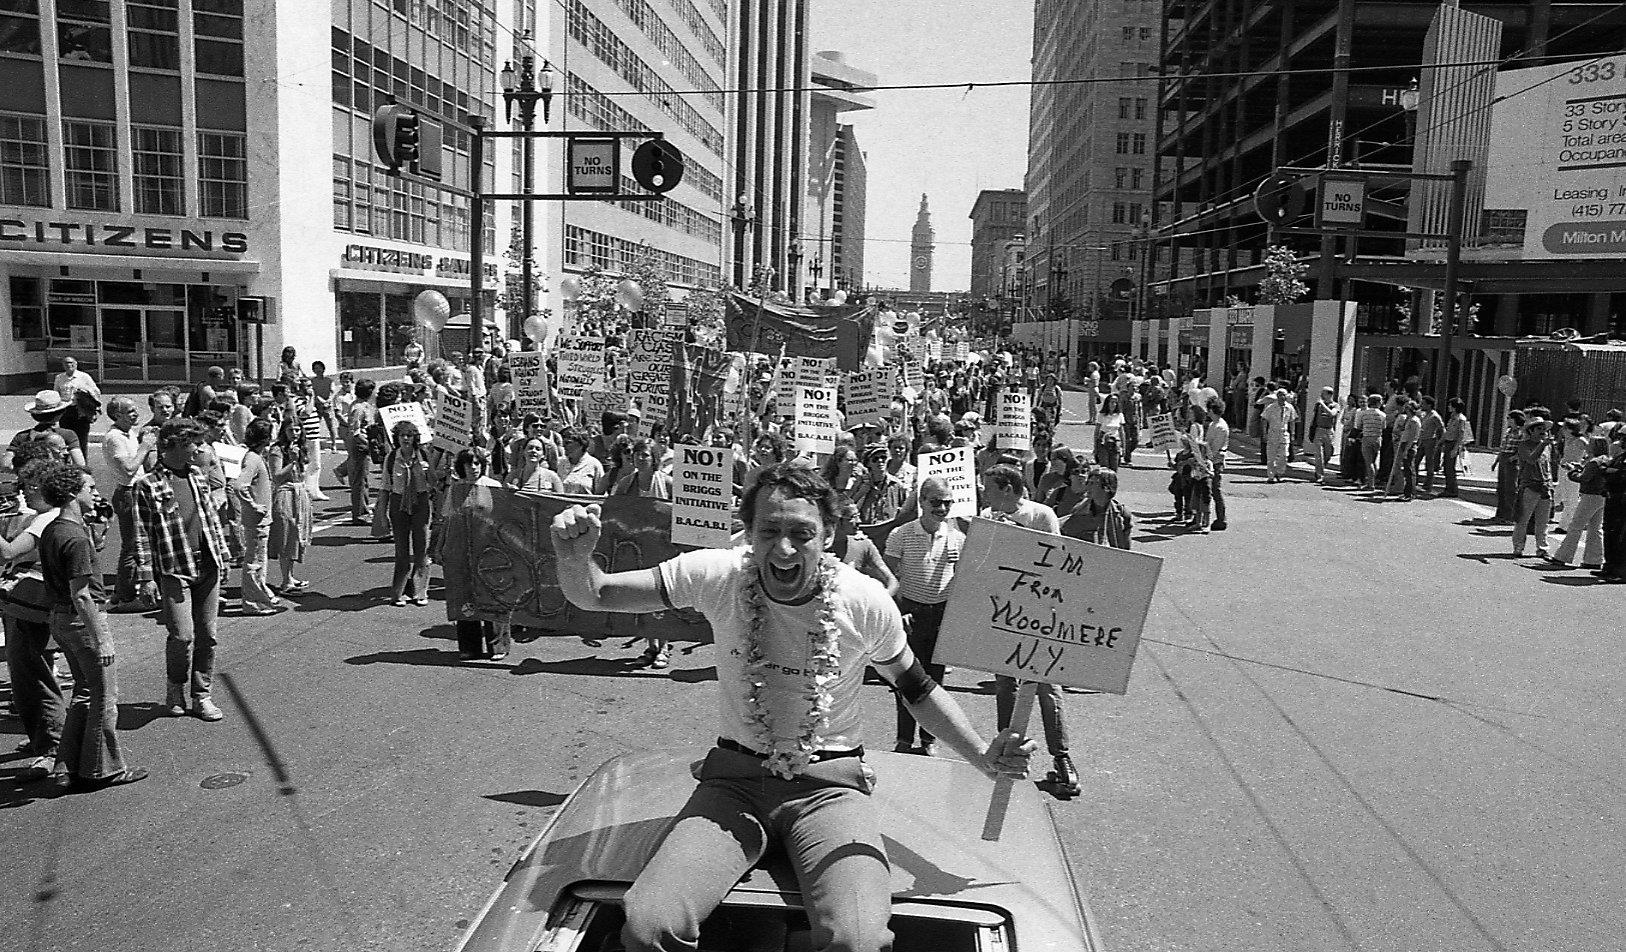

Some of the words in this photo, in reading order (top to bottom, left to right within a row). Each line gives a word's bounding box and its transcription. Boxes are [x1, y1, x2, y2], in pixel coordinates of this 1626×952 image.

[1568, 62, 1615, 84] 333
[1564, 105, 1585, 117] 33
[1563, 120, 1573, 132] 5
[1578, 118, 1619, 131] Story
[1562, 133, 1594, 147] Total
[584, 156, 601, 165] NO
[574, 165, 612, 175] TURNS
[1334, 194, 1351, 202] NO
[1554, 187, 1608, 200] Leasing
[1323, 202, 1361, 212] TURNS
[1572, 204, 1603, 217] (415)
[1608, 203, 1626, 215] 77
[0, 219, 248, 252] CITIZENS
[1563, 231, 1607, 243] Milton
[345, 244, 432, 270] CITIZENS
[634, 330, 684, 342] RACISM
[802, 359, 822, 368] NO!
[850, 373, 872, 384] NO!
[804, 389, 831, 401] NO!
[1004, 395, 1026, 404] NO!
[443, 394, 467, 411] NO!
[683, 449, 723, 467] NO!
[929, 450, 965, 466] NO!
[683, 471, 698, 480] ON
[701, 473, 722, 482] THE
[683, 484, 722, 496] BRIGGS
[676, 497, 729, 511] INITIATIVE
[782, 667, 800, 676] go
